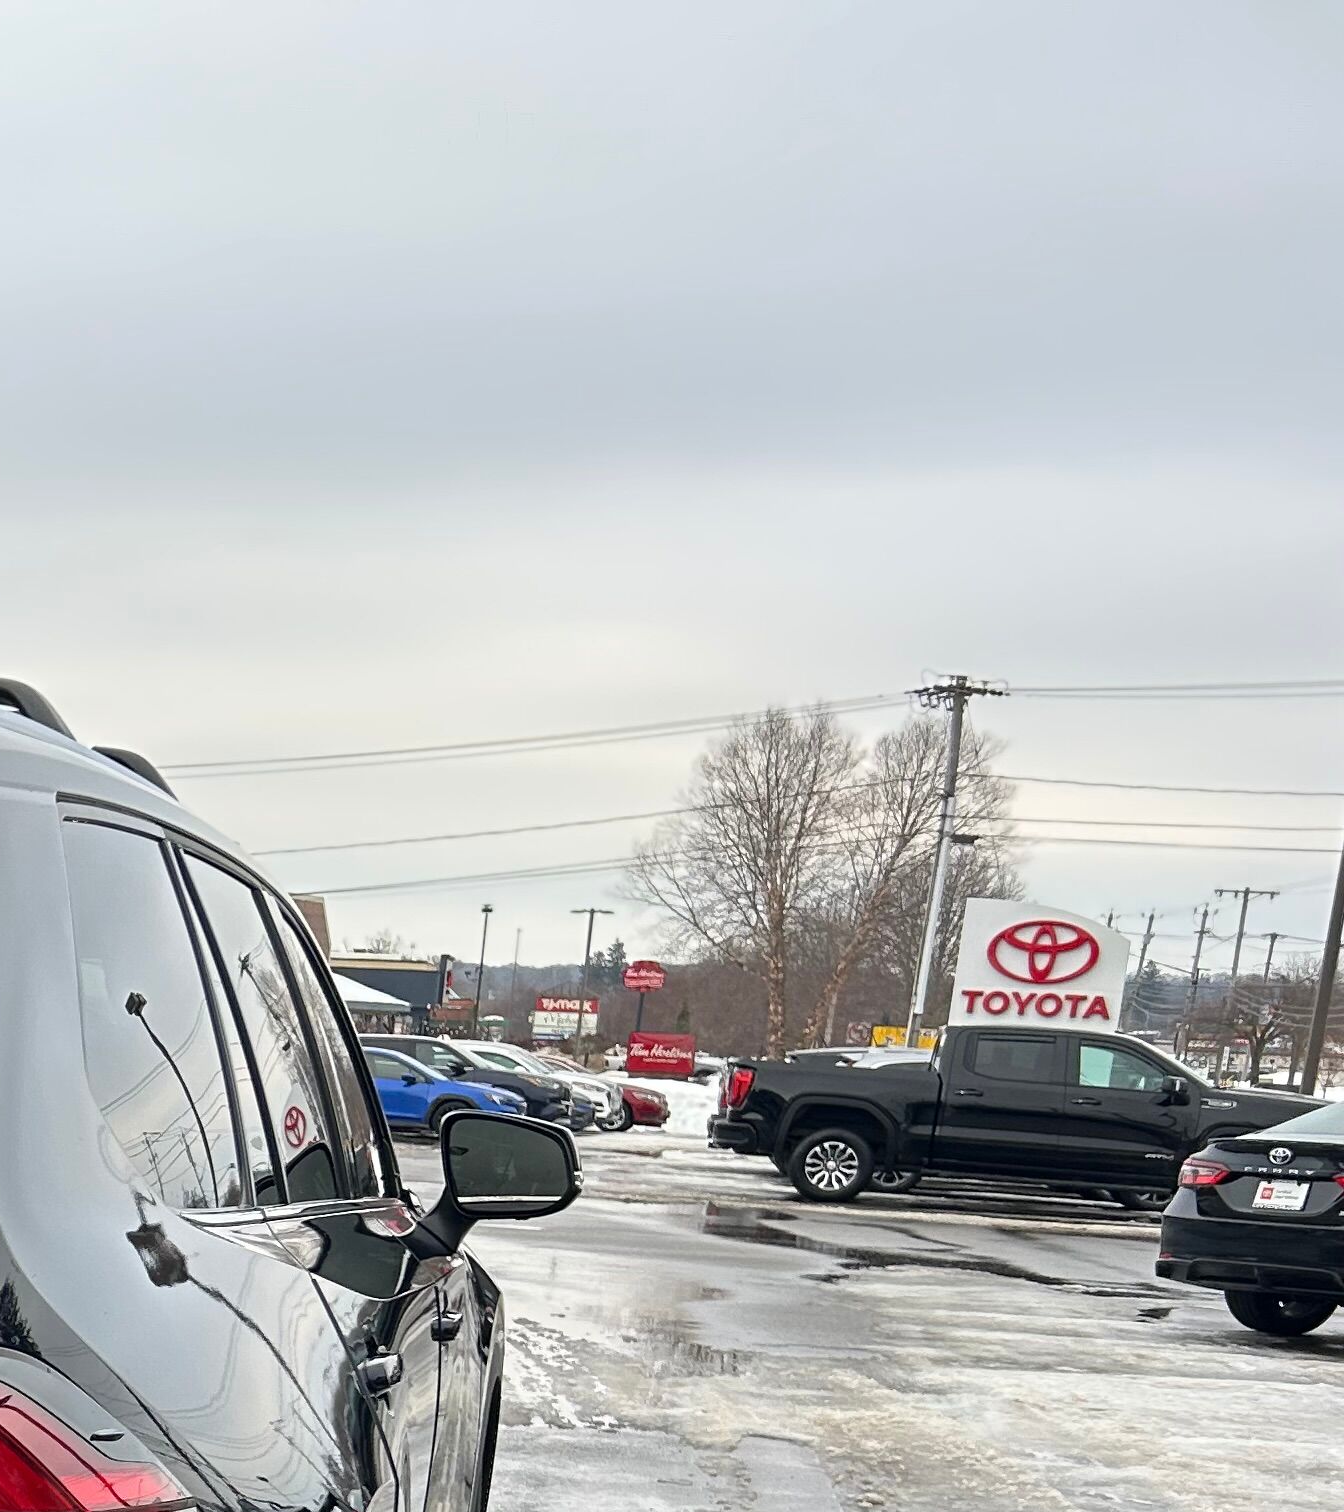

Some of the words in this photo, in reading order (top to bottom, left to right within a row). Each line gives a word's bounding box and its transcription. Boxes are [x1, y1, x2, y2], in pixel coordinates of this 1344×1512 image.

[962, 989, 1110, 1020] TOYOTA
[630, 1043, 649, 1057] Tim
[650, 1043, 693, 1059] Hortons
